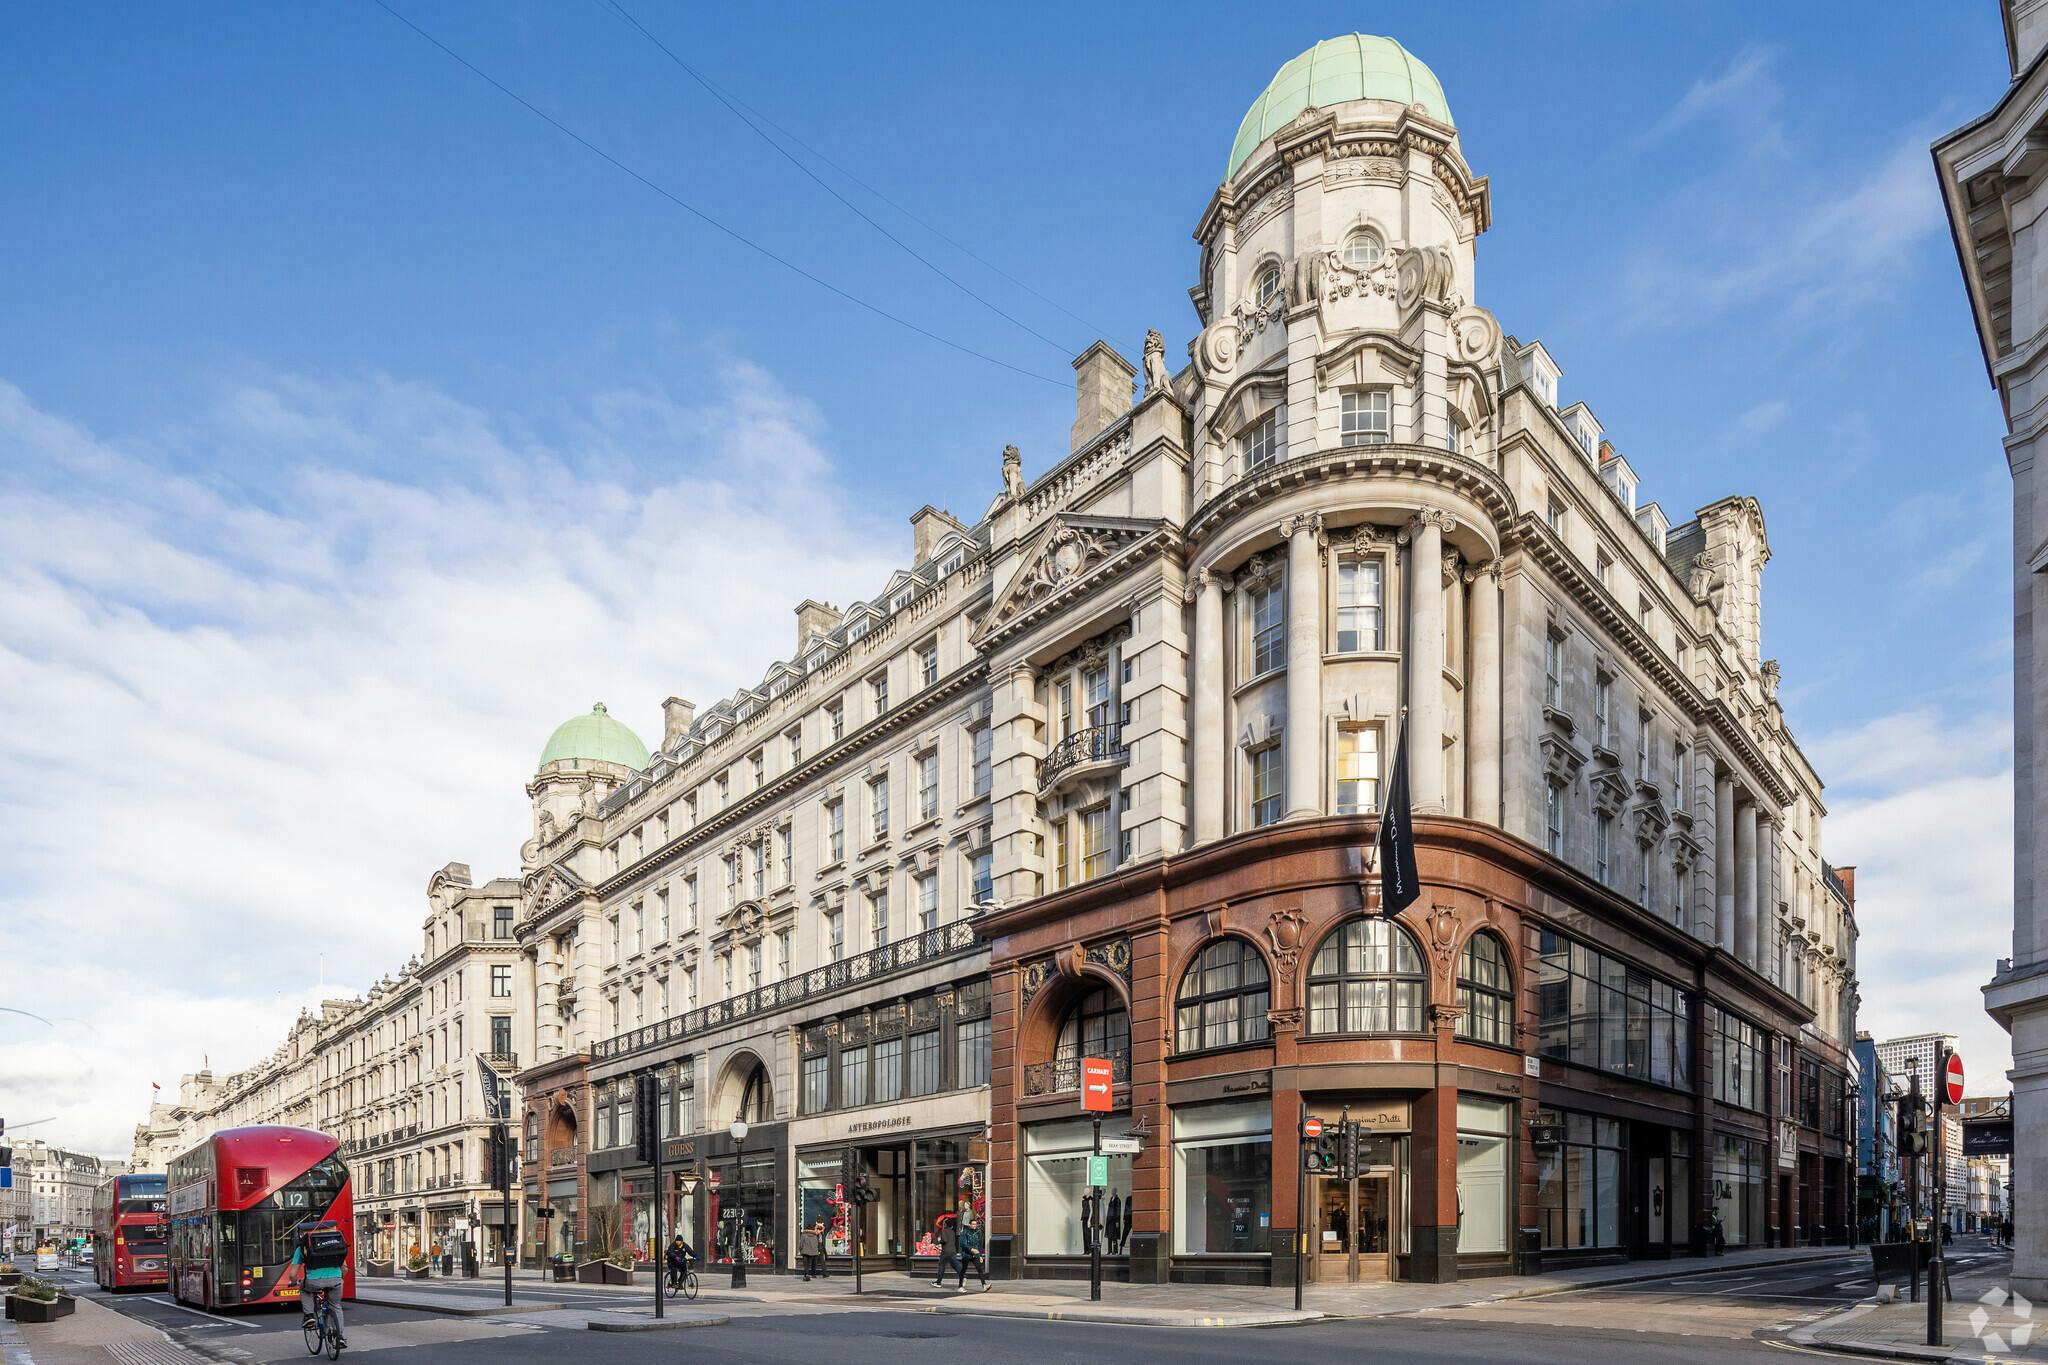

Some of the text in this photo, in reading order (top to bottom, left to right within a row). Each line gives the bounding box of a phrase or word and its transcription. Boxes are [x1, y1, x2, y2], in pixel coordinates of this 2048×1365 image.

[1389, 807, 1398, 841] Dutti
[1087, 1067, 1110, 1076] CARNABY
[482, 1072, 495, 1115] CAIN KLEIN
[848, 1115, 913, 1134] ANTHROPOLOGIE
[1378, 1113, 1401, 1124] Dutti
[668, 1142, 694, 1157] GUESS
[153, 1202, 166, 1212] 94
[290, 1193, 304, 1207] 12
